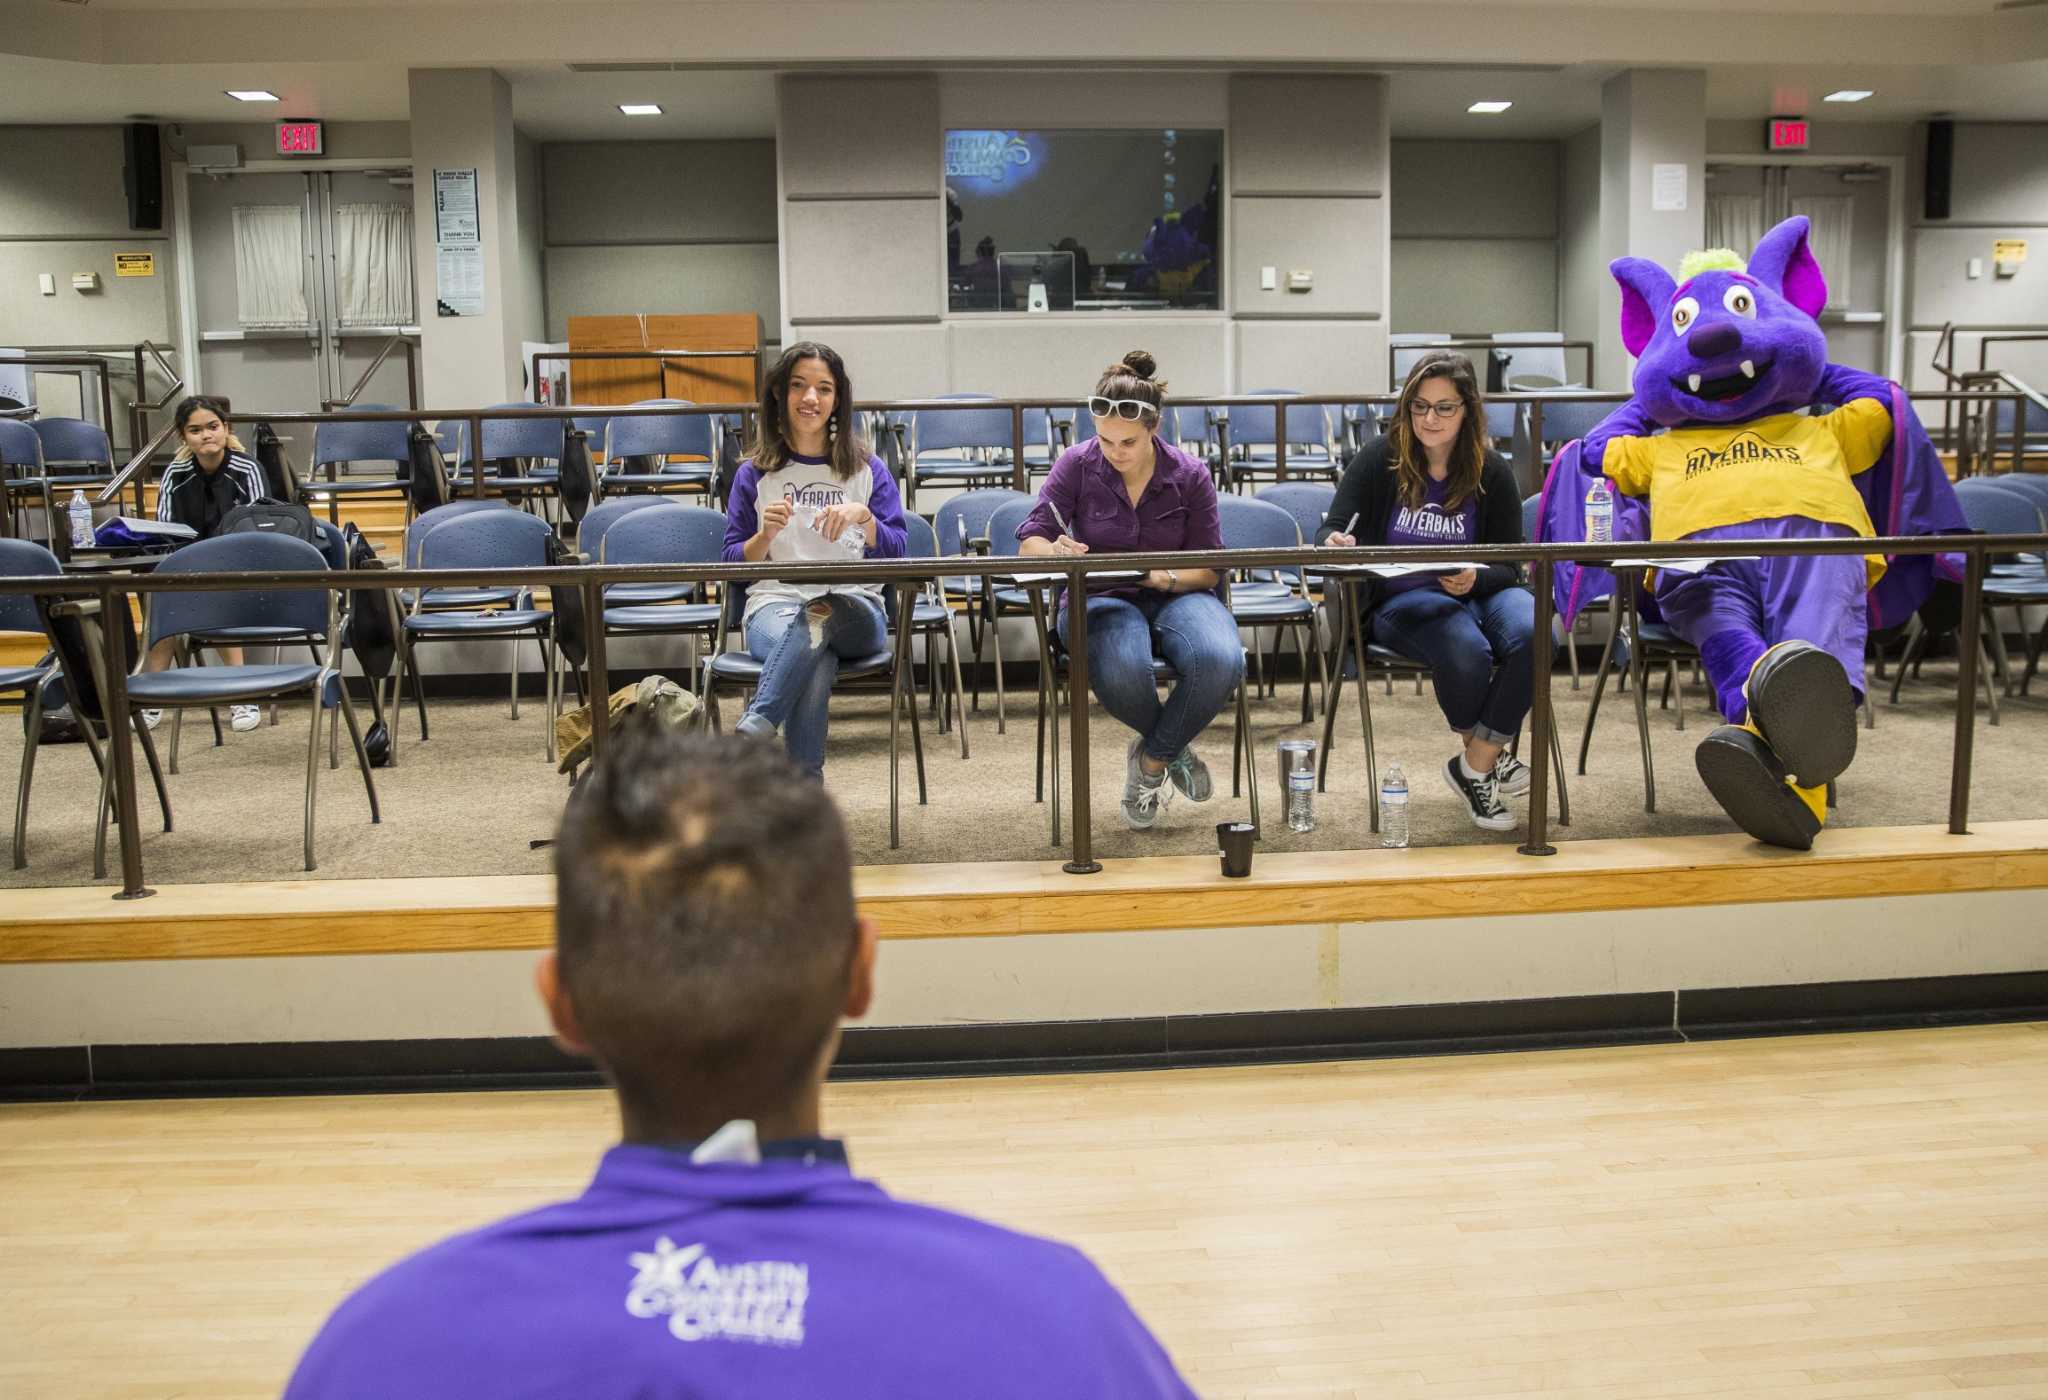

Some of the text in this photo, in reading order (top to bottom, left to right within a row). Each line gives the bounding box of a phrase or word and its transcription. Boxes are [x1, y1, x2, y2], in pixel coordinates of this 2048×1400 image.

[281, 124, 317, 151] EXIT
[1776, 122, 1807, 147] EXIT
[1686, 440, 1800, 475] RIVERBATS
[1397, 507, 1465, 534] RIVERBATS
